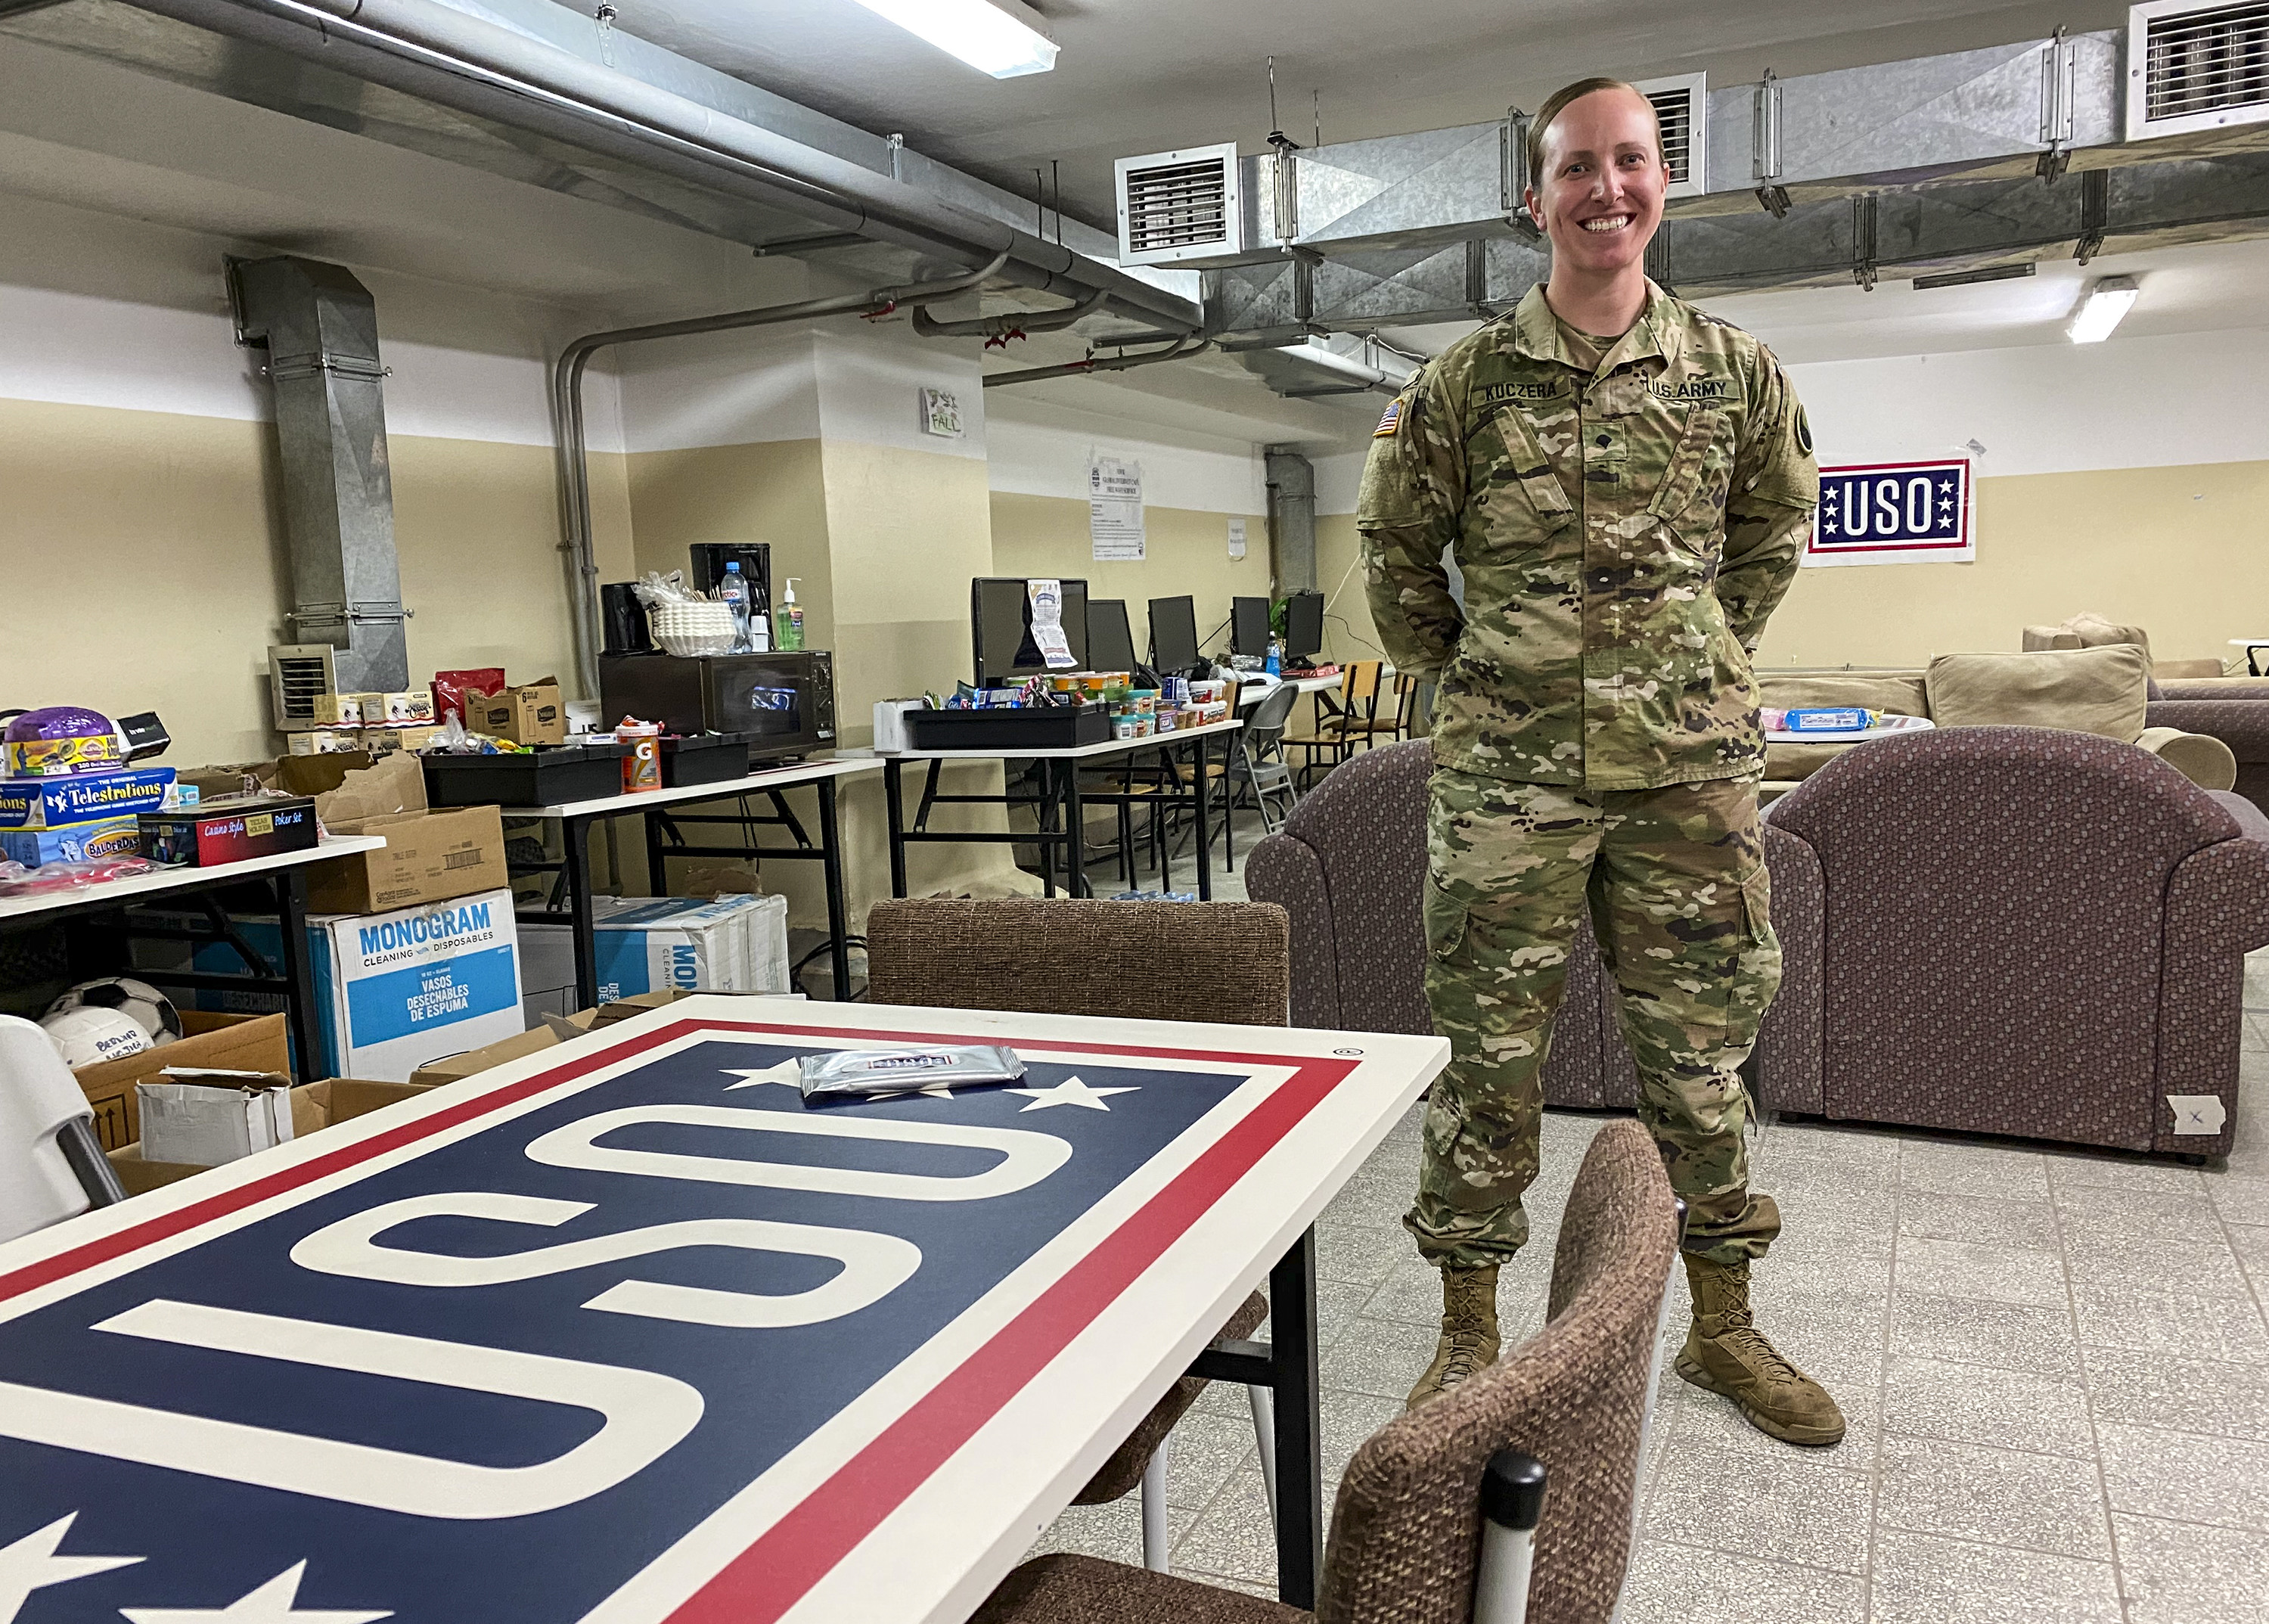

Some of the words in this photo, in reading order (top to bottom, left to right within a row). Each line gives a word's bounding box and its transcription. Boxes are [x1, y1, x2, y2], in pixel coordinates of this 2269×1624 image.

[1485, 382, 1557, 402] KUCZERA
[1678, 381, 1727, 399] ARMY
[931, 413, 961, 432] FALL
[1843, 477, 1933, 536] USO
[522, 691, 527, 703] 6
[636, 742, 653, 760] G
[0, 798, 26, 810] ions
[68, 783, 162, 806] Telestrations
[204, 823, 228, 837] Casino
[228, 818, 244, 838] Style
[250, 817, 268, 826] TEXAS
[275, 812, 291, 826] Poker
[292, 811, 303, 823] Set
[88, 837, 139, 856] BALDERDAS
[359, 902, 492, 956] MONOGRAM
[363, 949, 414, 967] CLEANING
[433, 931, 494, 952] DISPOSABLES
[662, 948, 672, 989] CLEANIN
[672, 945, 697, 991] MON
[421, 974, 452, 993] VASOS
[608, 983, 619, 1001] DES
[406, 983, 470, 1011] DESECHABLES
[410, 1008, 425, 1022] DE
[426, 996, 469, 1018] ESPUMA
[0, 1104, 1074, 1520] USO
